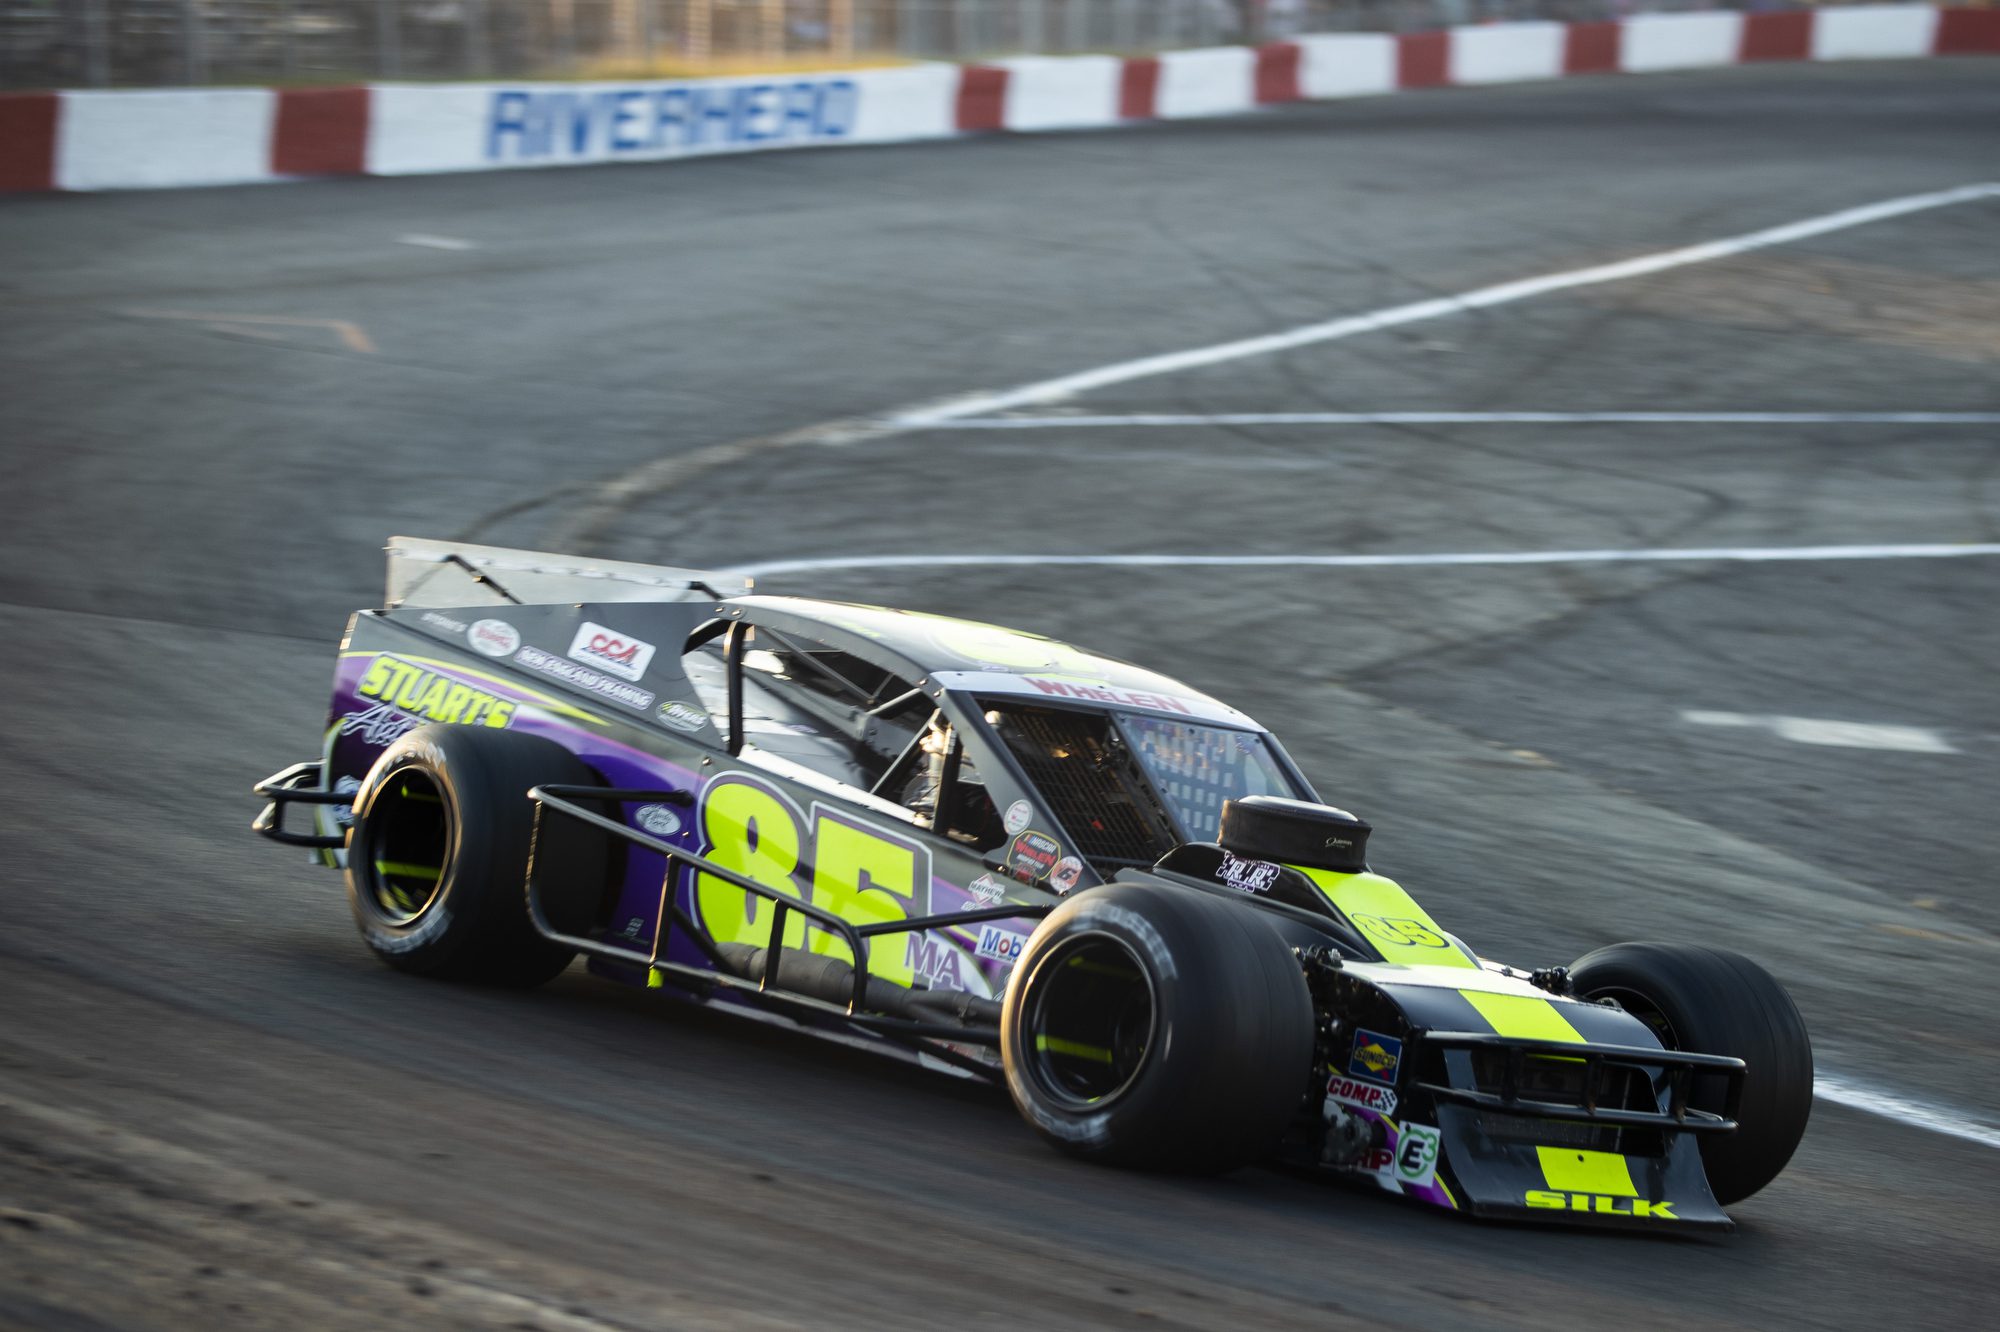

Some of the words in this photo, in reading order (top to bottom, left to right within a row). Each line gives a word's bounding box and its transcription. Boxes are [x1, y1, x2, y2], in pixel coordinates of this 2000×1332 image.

[485, 80, 859, 161] RIVERHEAD
[359, 656, 516, 729] STUART'S
[1021, 676, 1192, 715] WHELEN
[1030, 835, 1057, 854] NASCAR
[697, 780, 918, 990] 85
[982, 928, 1029, 958] Mob
[1351, 912, 1451, 949] 85
[1354, 1048, 1396, 1070] SUNOCO
[1328, 1078, 1382, 1106] COMP
[1524, 1189, 1680, 1220] SILK
